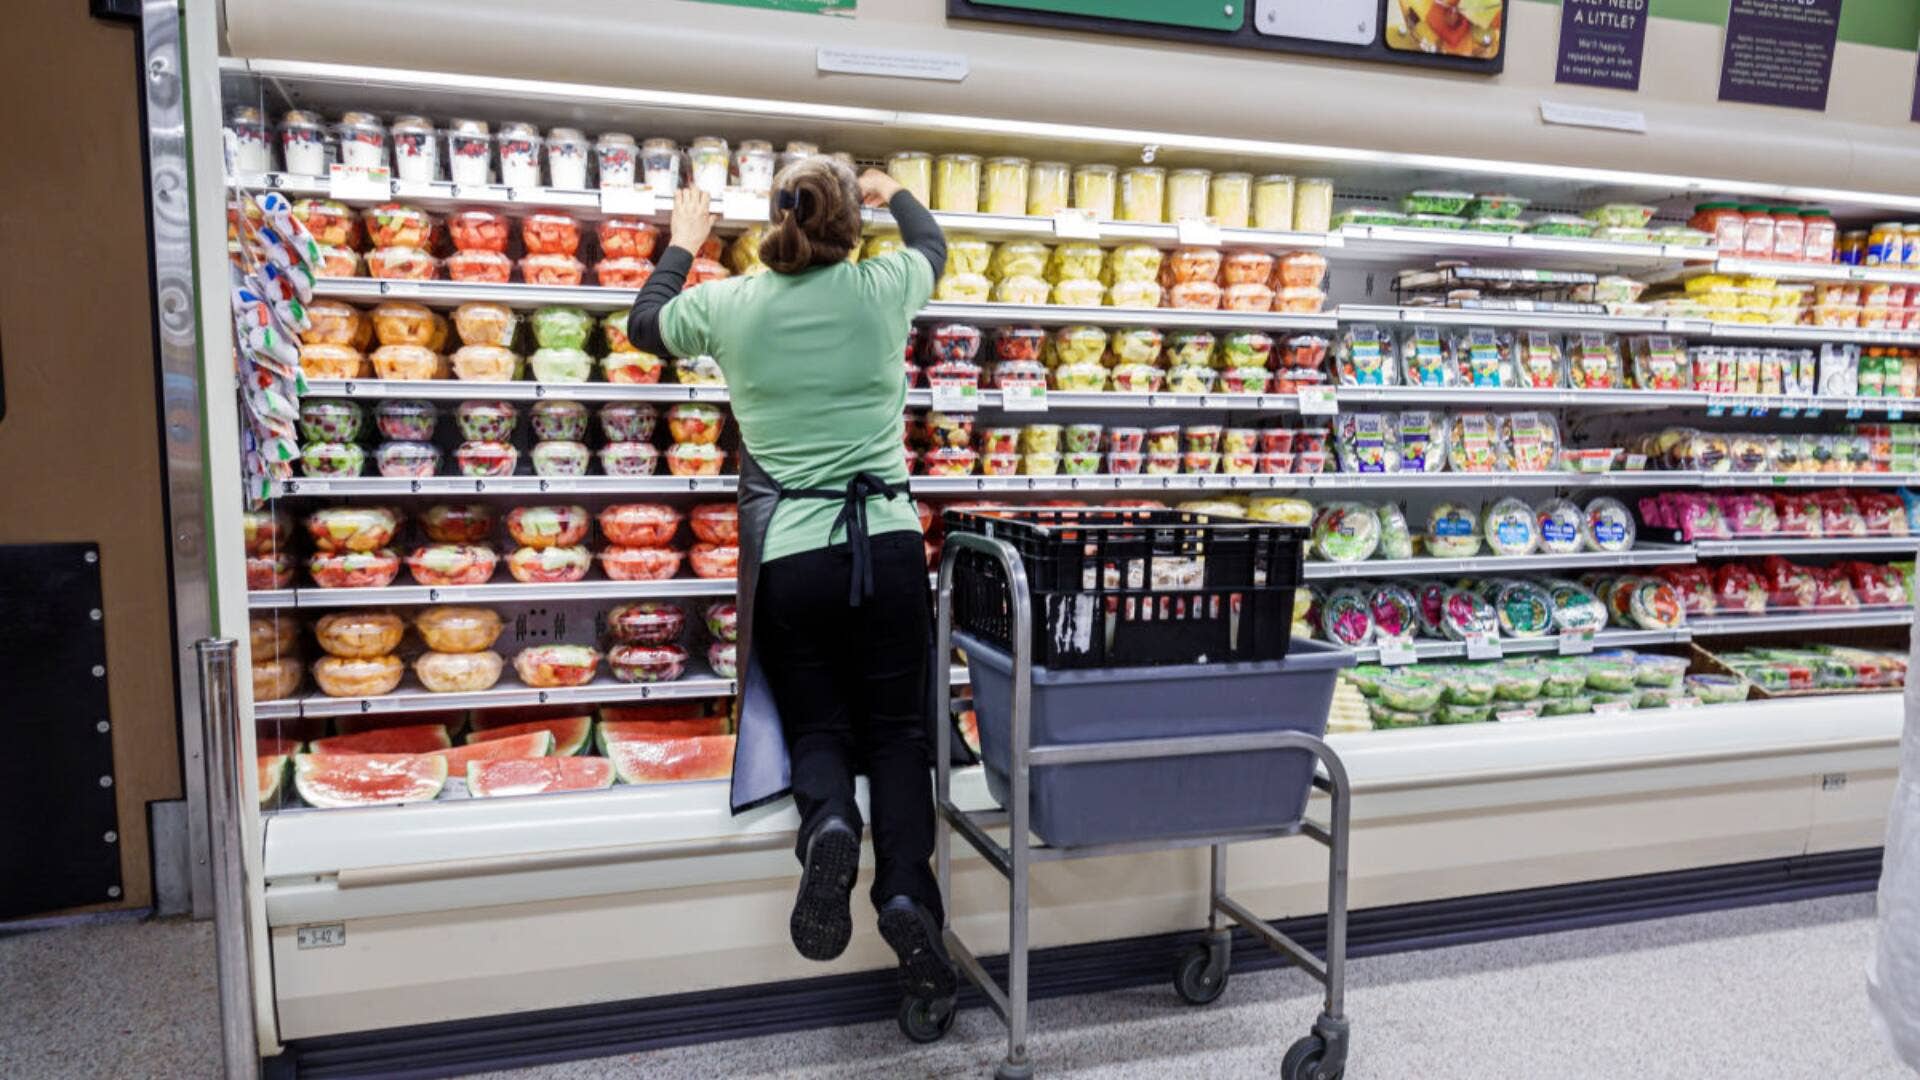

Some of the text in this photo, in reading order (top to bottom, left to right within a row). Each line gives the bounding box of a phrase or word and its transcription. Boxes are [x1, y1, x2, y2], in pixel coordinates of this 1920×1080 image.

[1609, 0, 1644, 10] NEED
[1574, 9, 1635, 29] A LITTLE?
[1593, 68, 1609, 79] your
